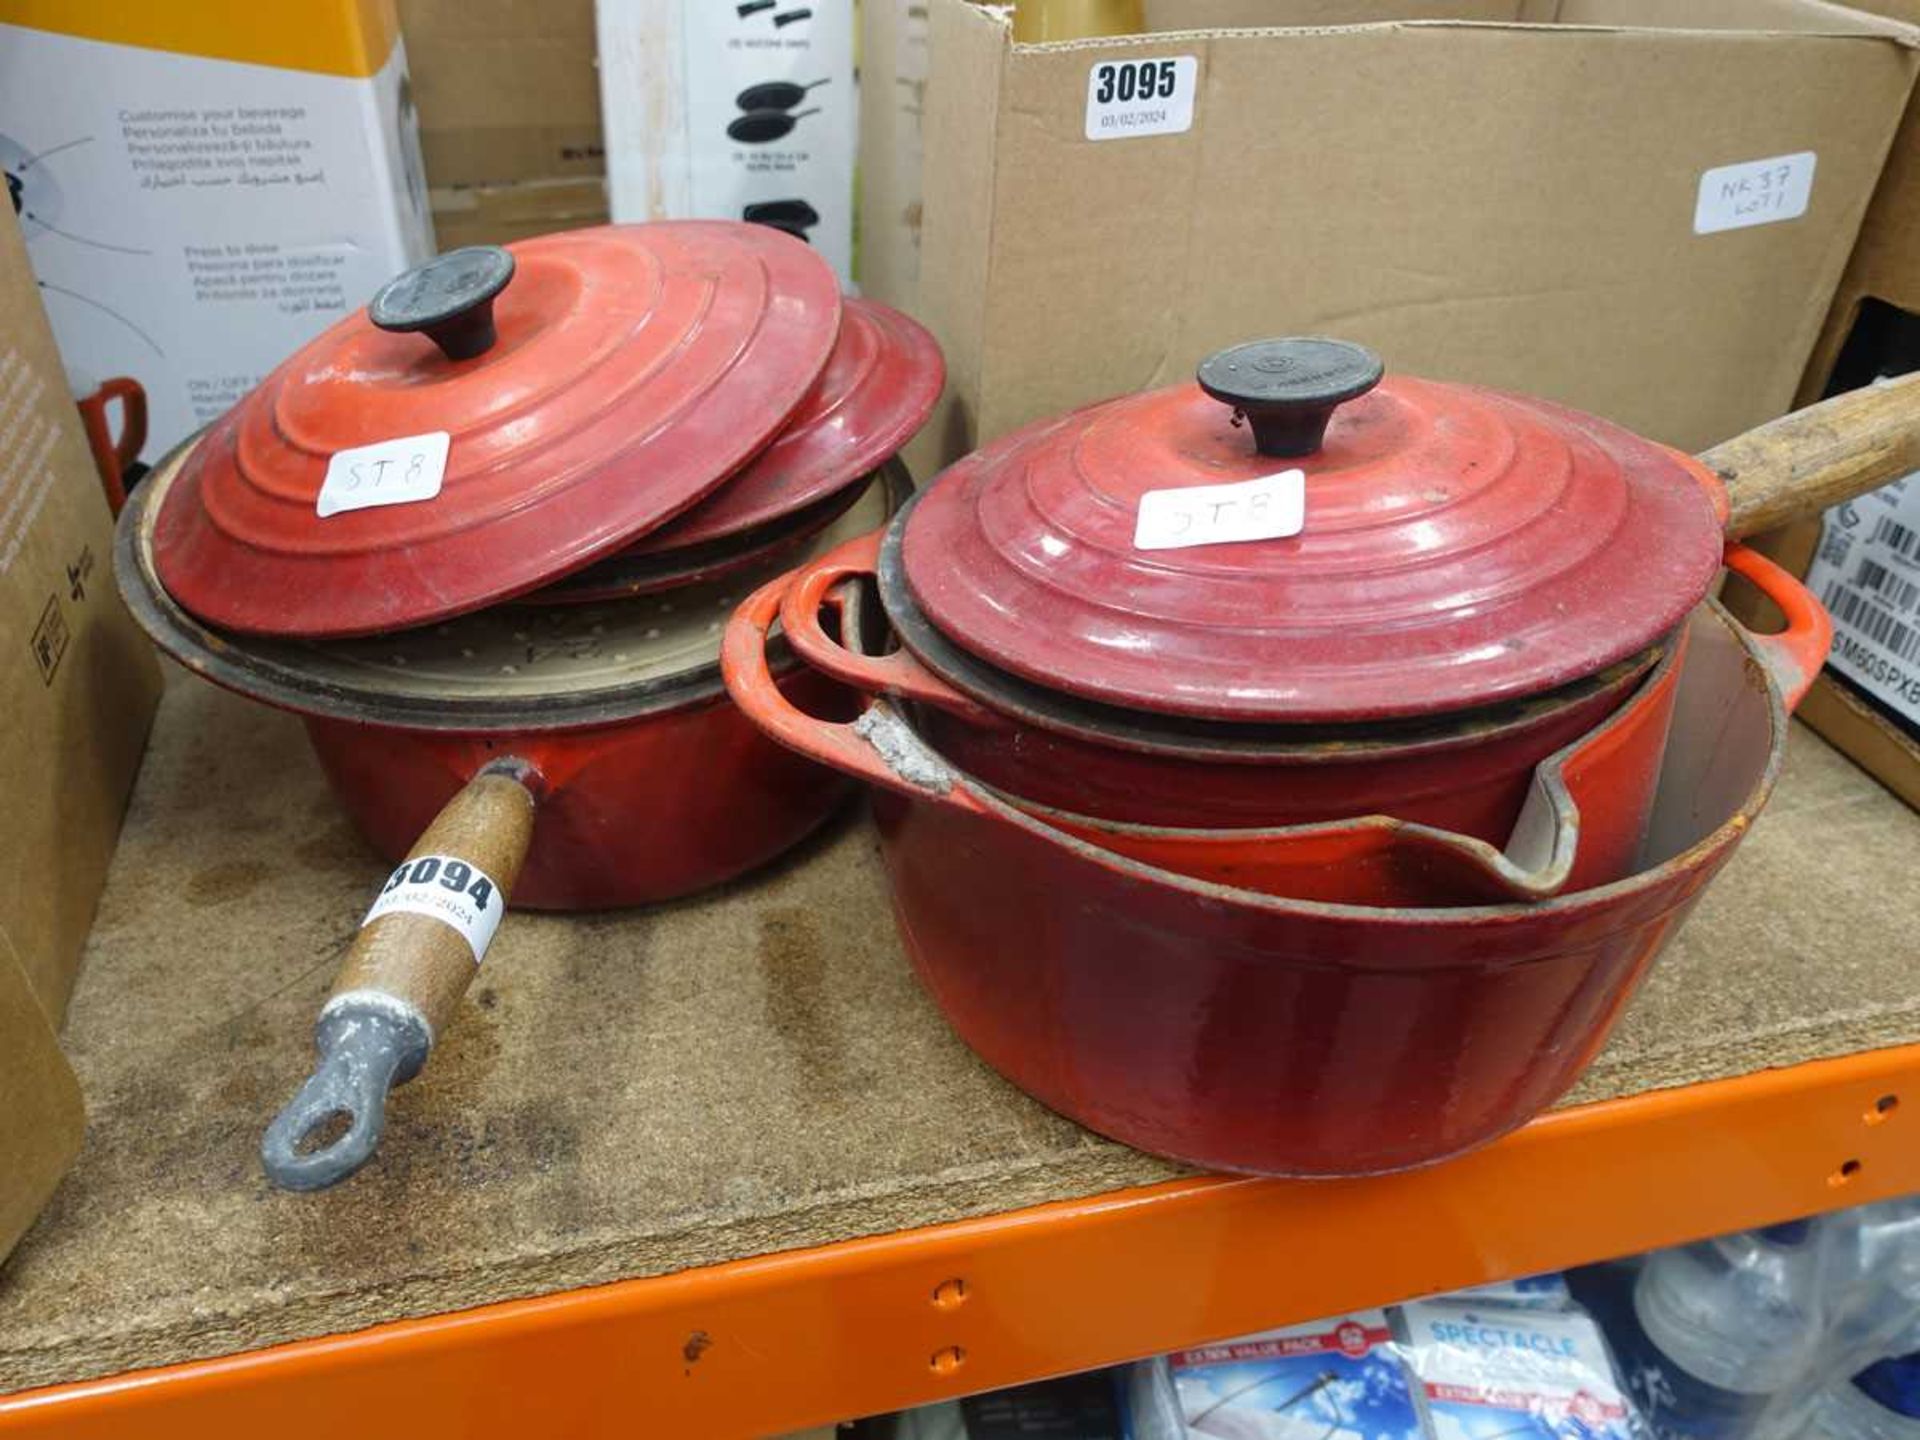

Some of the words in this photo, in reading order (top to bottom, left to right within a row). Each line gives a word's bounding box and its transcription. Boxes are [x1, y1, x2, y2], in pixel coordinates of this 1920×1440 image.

[1097, 61, 1176, 104] 3095
[203, 111, 234, 122] your
[238, 107, 306, 120] beverage
[1101, 110, 1167, 129] 03/02/2024
[123, 126, 209, 138] Personaliza
[232, 124, 283, 136] bebida
[1758, 164, 1792, 190] 37
[383, 857, 493, 912] 3094
[1429, 1320, 1577, 1358] SPECTACLE
